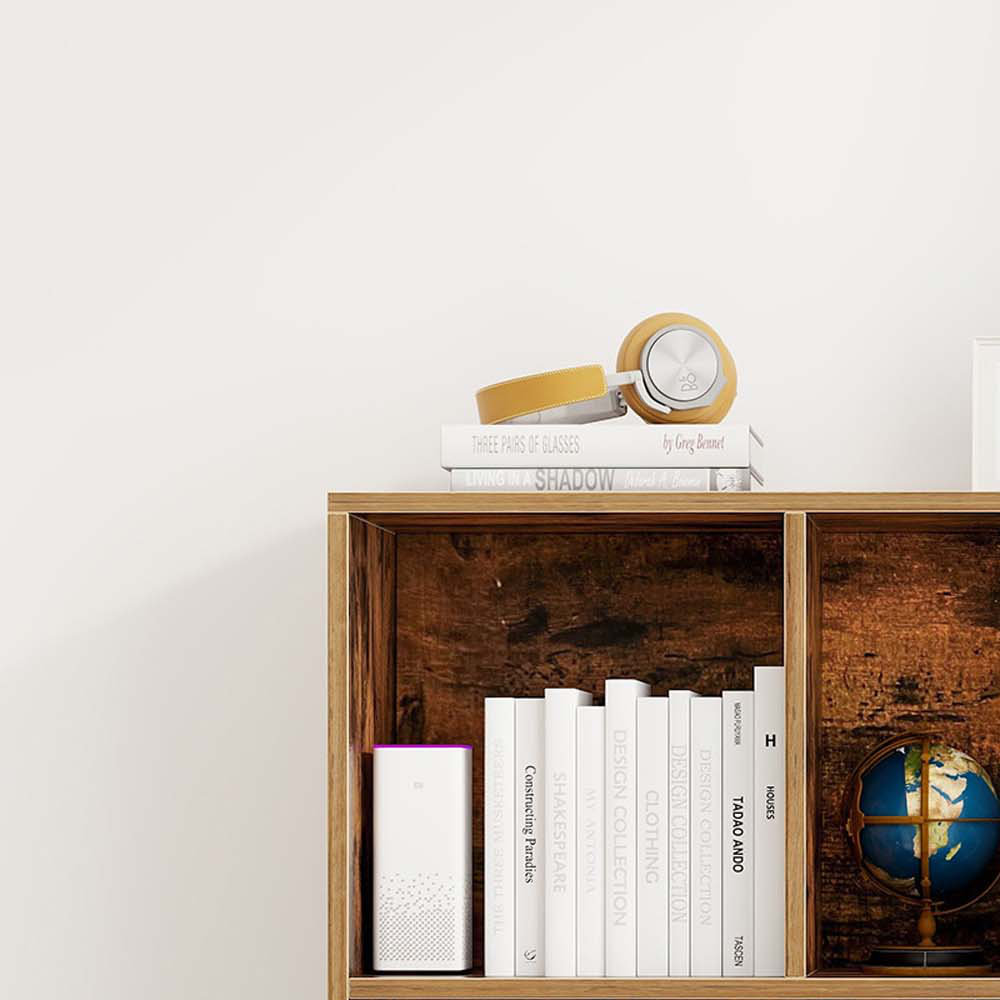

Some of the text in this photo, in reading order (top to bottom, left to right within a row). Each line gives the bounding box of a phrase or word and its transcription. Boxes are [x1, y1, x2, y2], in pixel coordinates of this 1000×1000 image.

[472, 435, 580, 454] THREE PAIRS OF GLASSES
[535, 469, 615, 491] SHADOW
[662, 433, 725, 455] by Greg Bennet
[521, 764, 537, 884] Constructing Paradies
[552, 770, 567, 895] SHAKESPEARE
[612, 729, 628, 927] DESIGN COLLECTION
[644, 790, 660, 885] CLOTHING
[671, 745, 688, 923] DESIGN COLLECTION
[699, 749, 713, 926] DESIGN COLLECTION
[732, 796, 744, 873] TADAO ANDO
[765, 785, 776, 820] HOUSES
[733, 935, 744, 967] TASCEN
